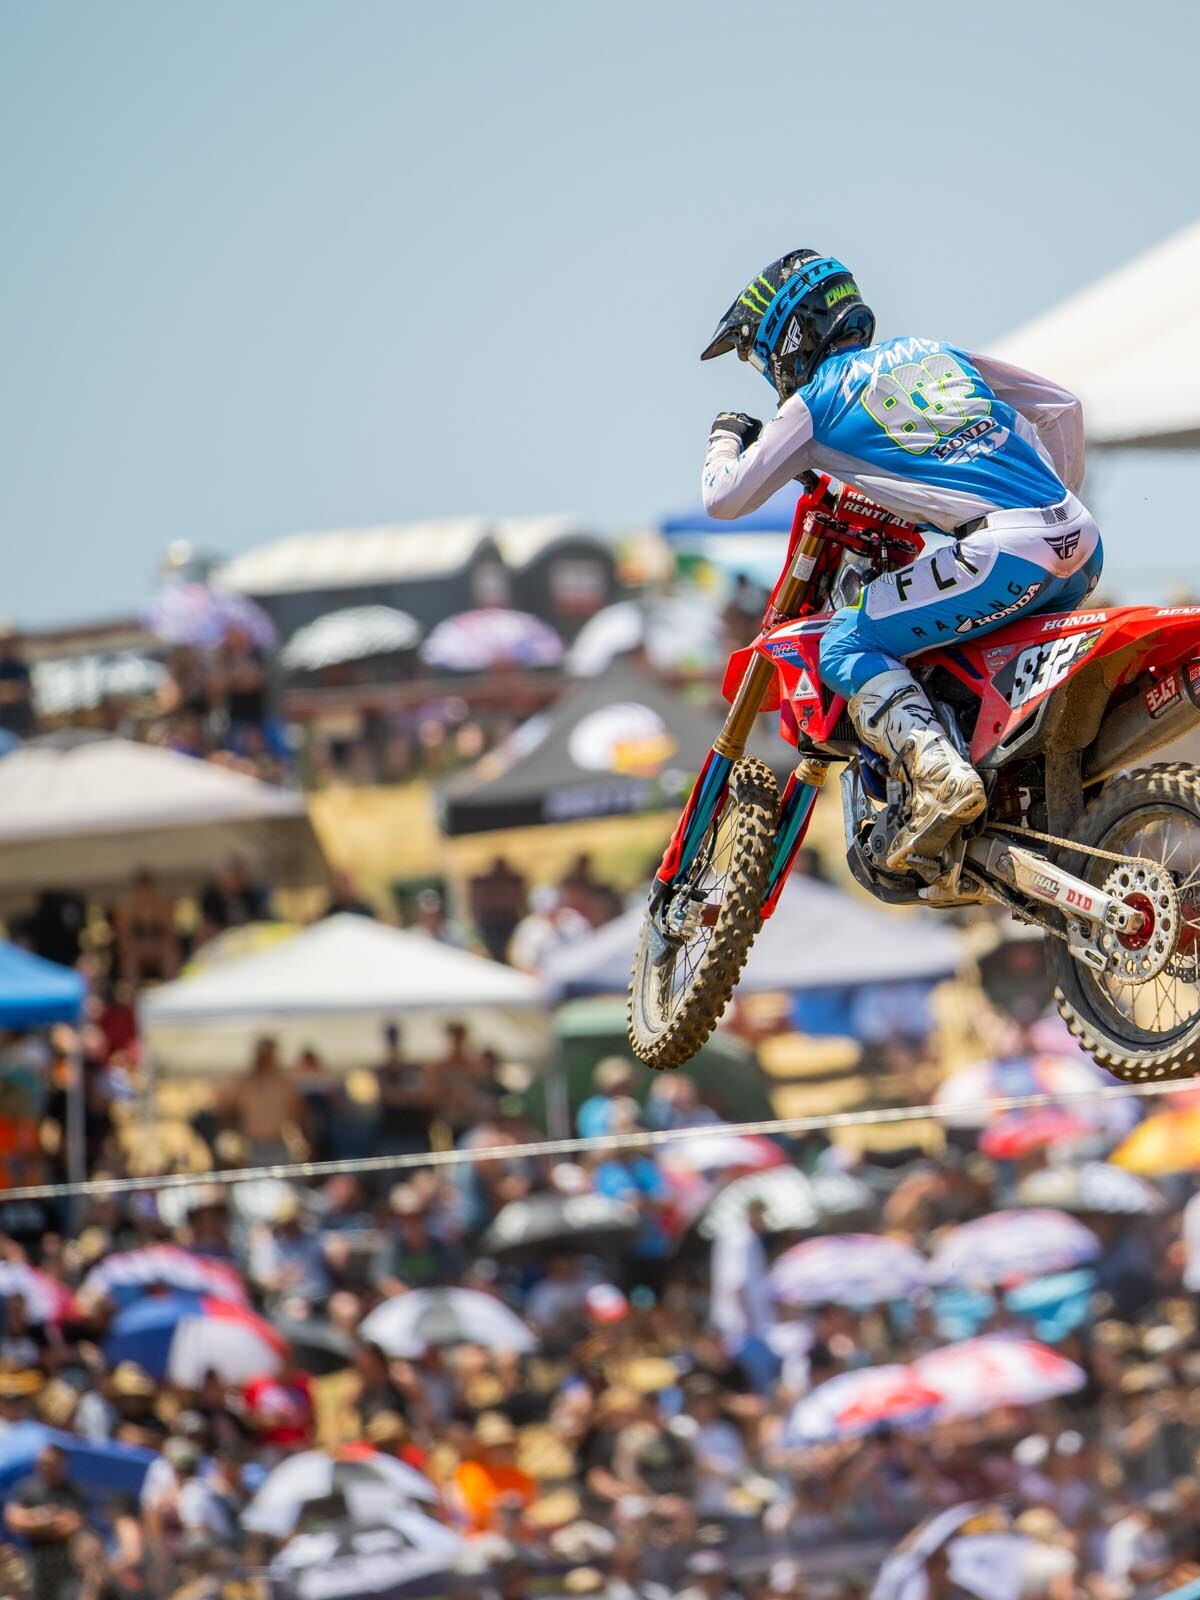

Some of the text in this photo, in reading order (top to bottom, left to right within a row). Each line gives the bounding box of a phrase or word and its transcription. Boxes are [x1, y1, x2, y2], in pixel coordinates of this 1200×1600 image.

[972, 582, 1042, 626] HONDA
[1041, 612, 1107, 632] HONDA
[1011, 632, 1087, 709] 832
